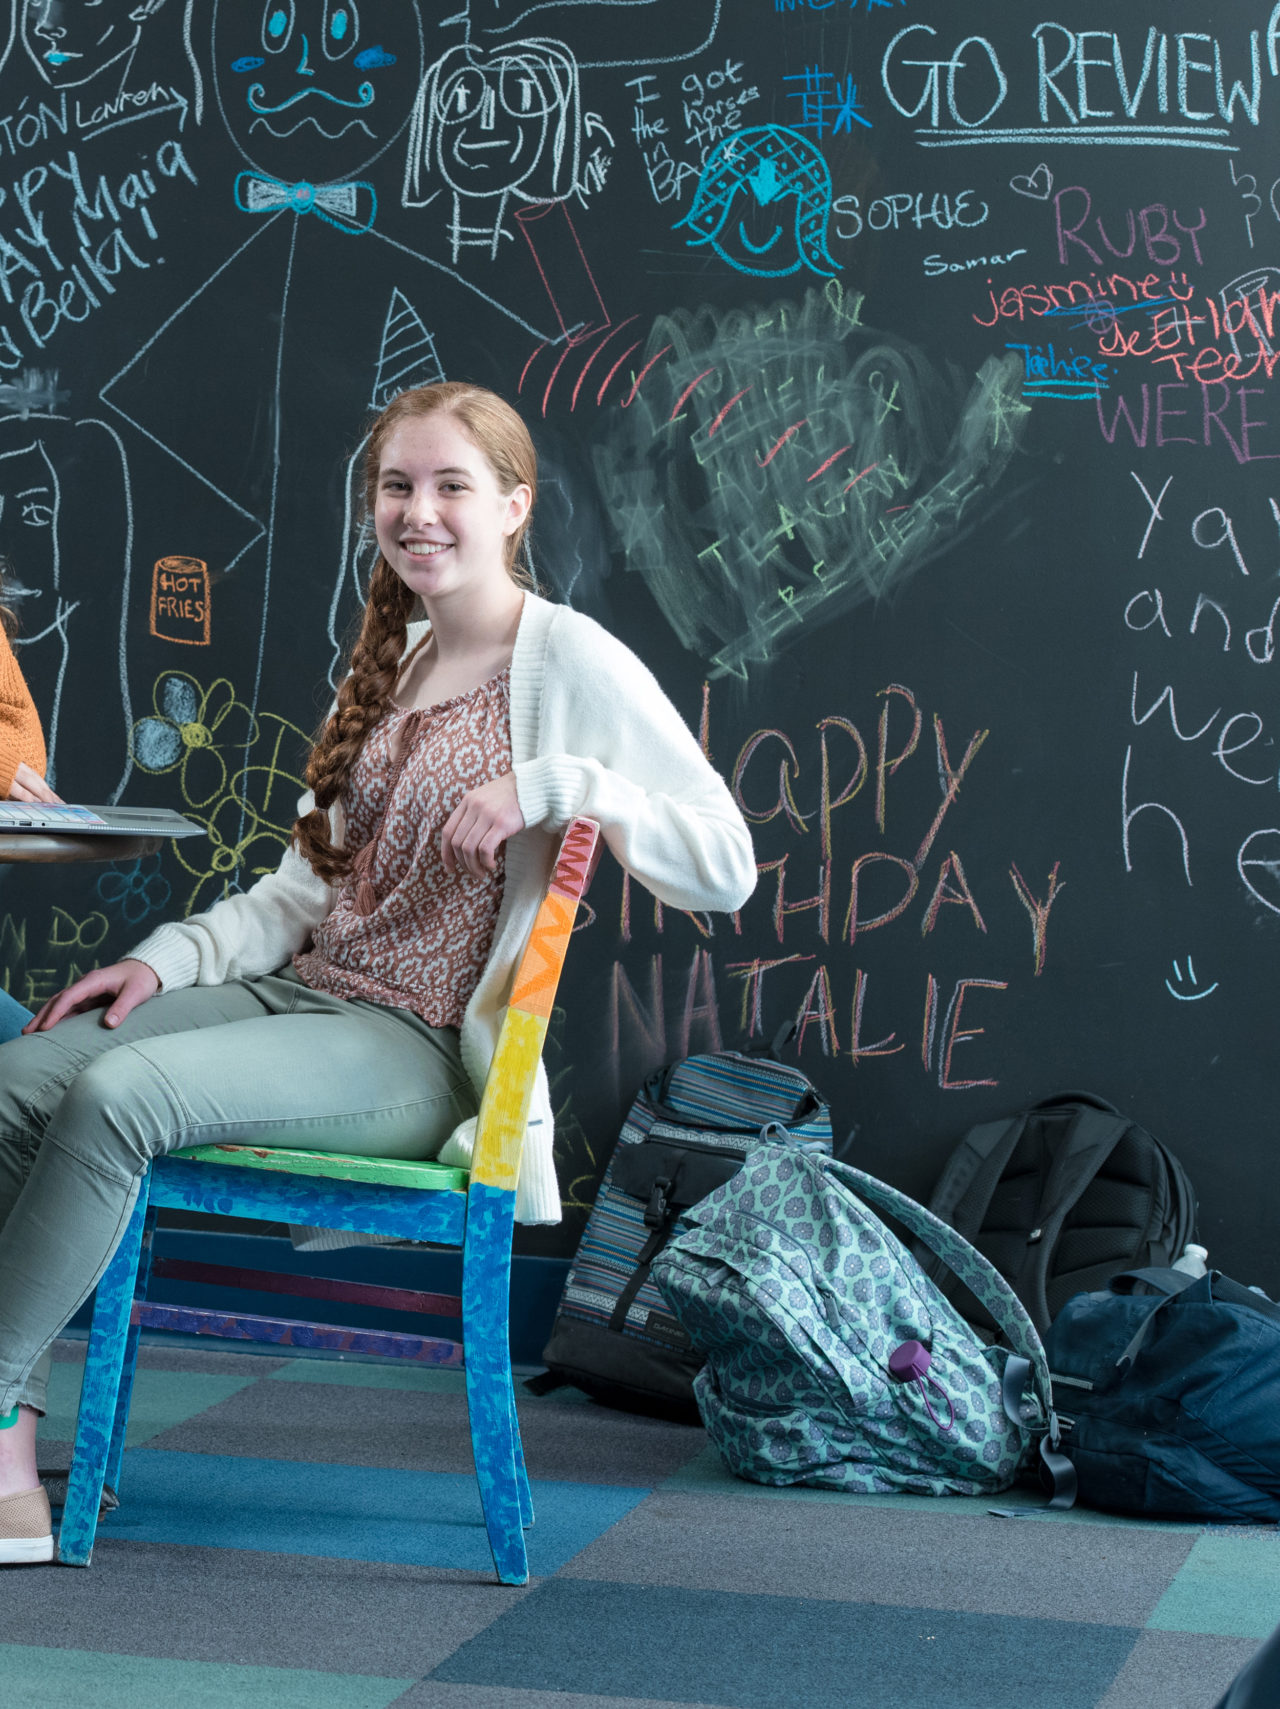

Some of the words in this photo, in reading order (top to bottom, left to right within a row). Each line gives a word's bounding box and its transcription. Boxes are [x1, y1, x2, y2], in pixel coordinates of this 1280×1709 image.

[625, 75, 661, 104] I
[882, 24, 1008, 127] GO
[1032, 22, 1261, 126] REVIEW
[631, 106, 669, 147] the
[1054, 186, 1207, 265] RUBY
[1094, 376, 1280, 464] WERE
[158, 596, 204, 622] FRIES
[159, 573, 201, 593] HOT
[612, 944, 1009, 1090] NATALIE
